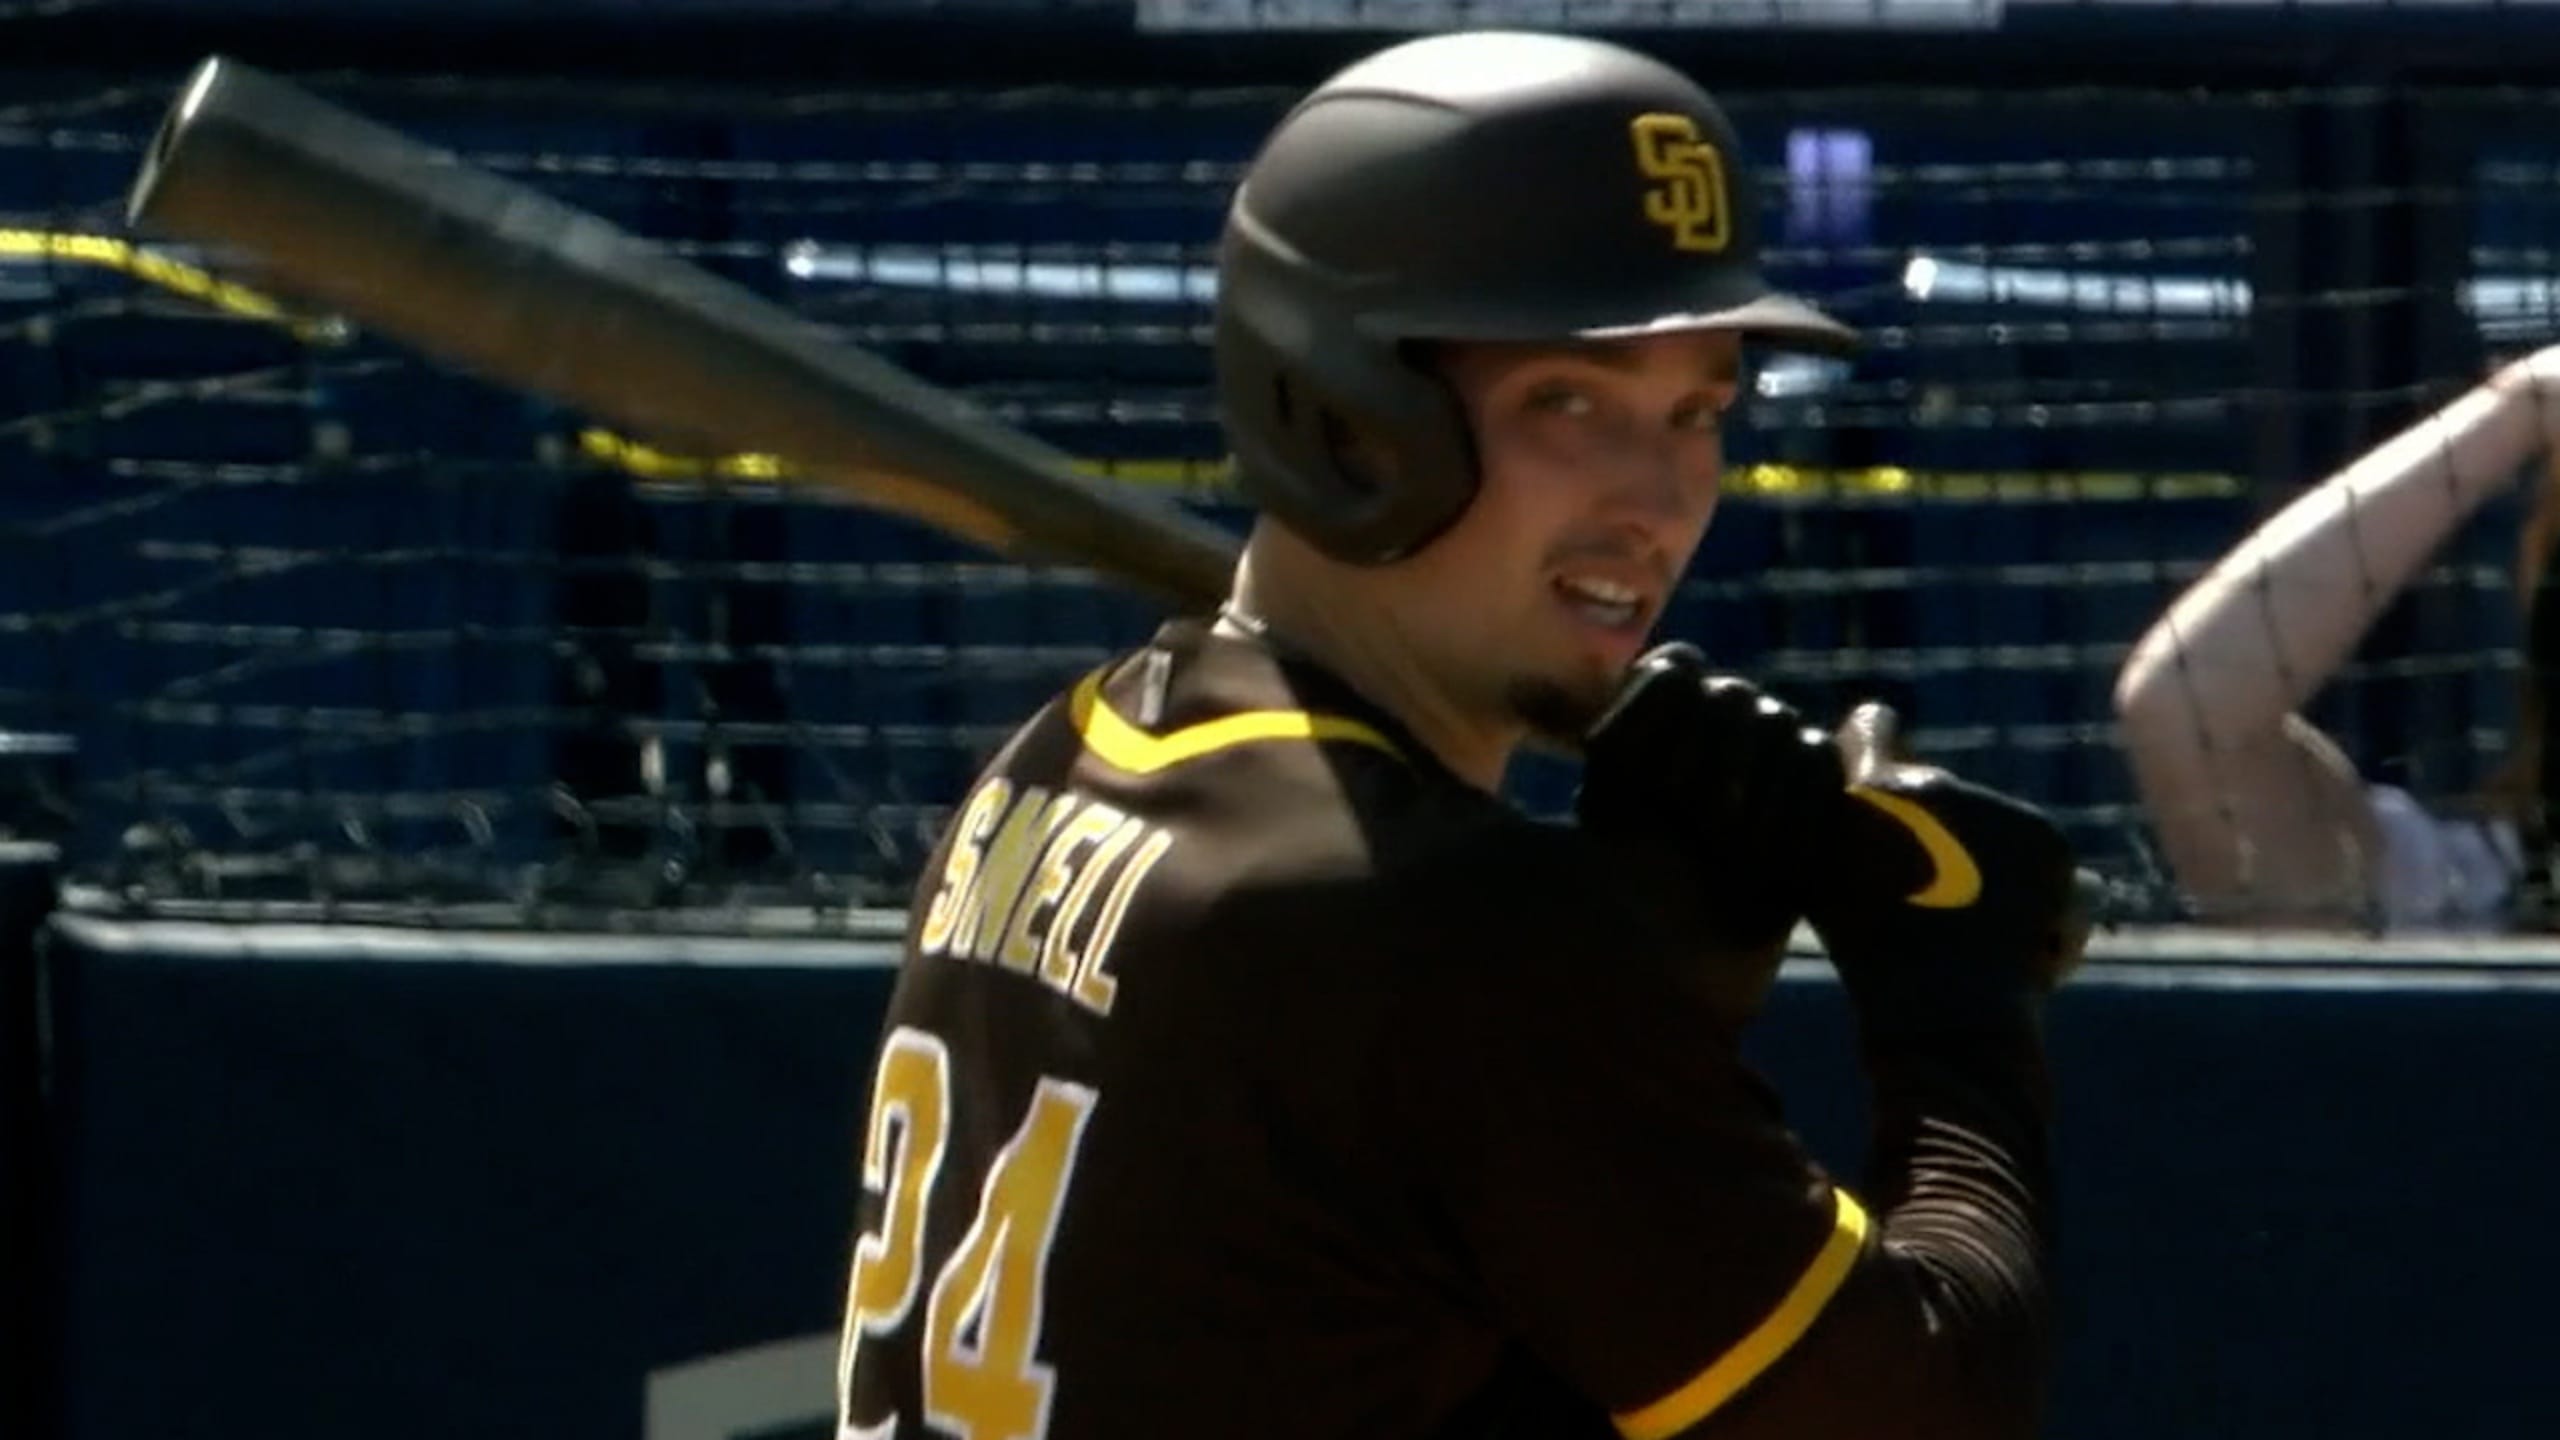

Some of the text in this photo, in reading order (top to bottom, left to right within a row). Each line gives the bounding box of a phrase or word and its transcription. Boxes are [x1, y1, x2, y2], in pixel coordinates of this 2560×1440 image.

[1632, 112, 1728, 250] SD
[920, 777, 1173, 1016] SNELL
[837, 1026, 1099, 1440] 24
